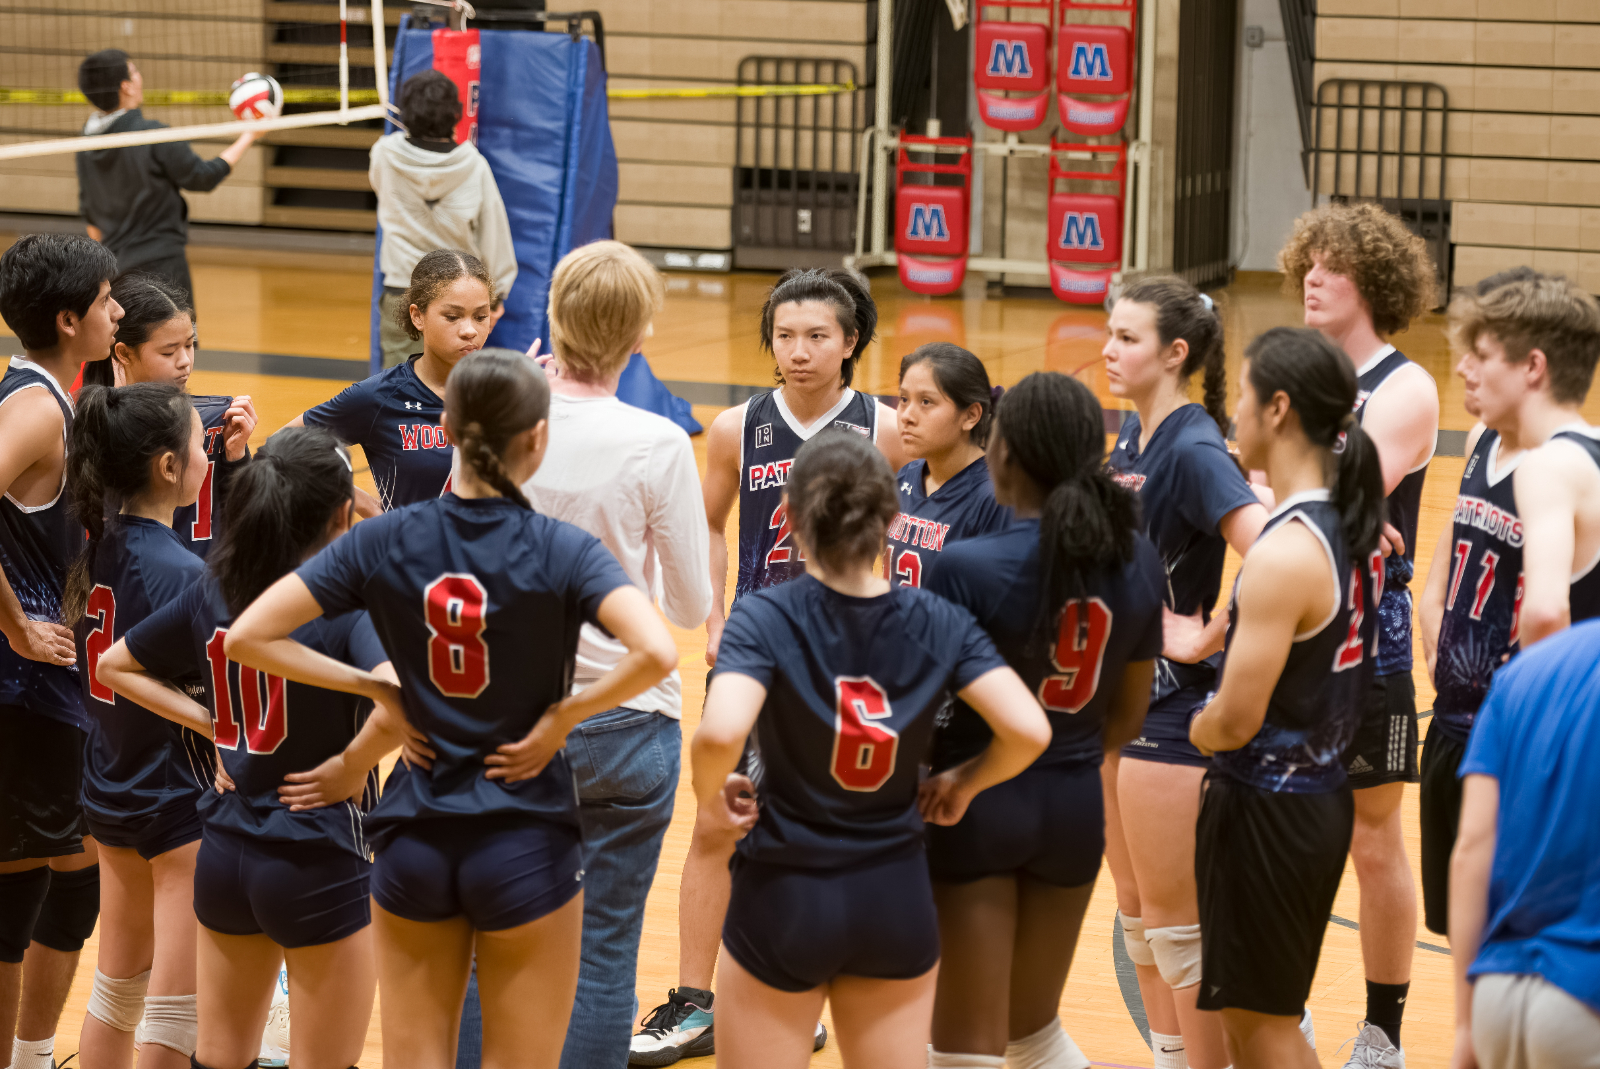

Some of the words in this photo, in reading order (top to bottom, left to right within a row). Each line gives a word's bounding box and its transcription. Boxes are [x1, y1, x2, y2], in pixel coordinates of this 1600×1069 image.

[398, 423, 455, 451] WOO
[749, 458, 796, 492] PAT
[765, 501, 807, 570] 2
[1445, 538, 1501, 622] 11
[85, 582, 117, 706] 2
[206, 626, 288, 755] 10
[423, 571, 491, 700] 8
[1037, 596, 1114, 715] 9
[829, 675, 900, 793] 6
